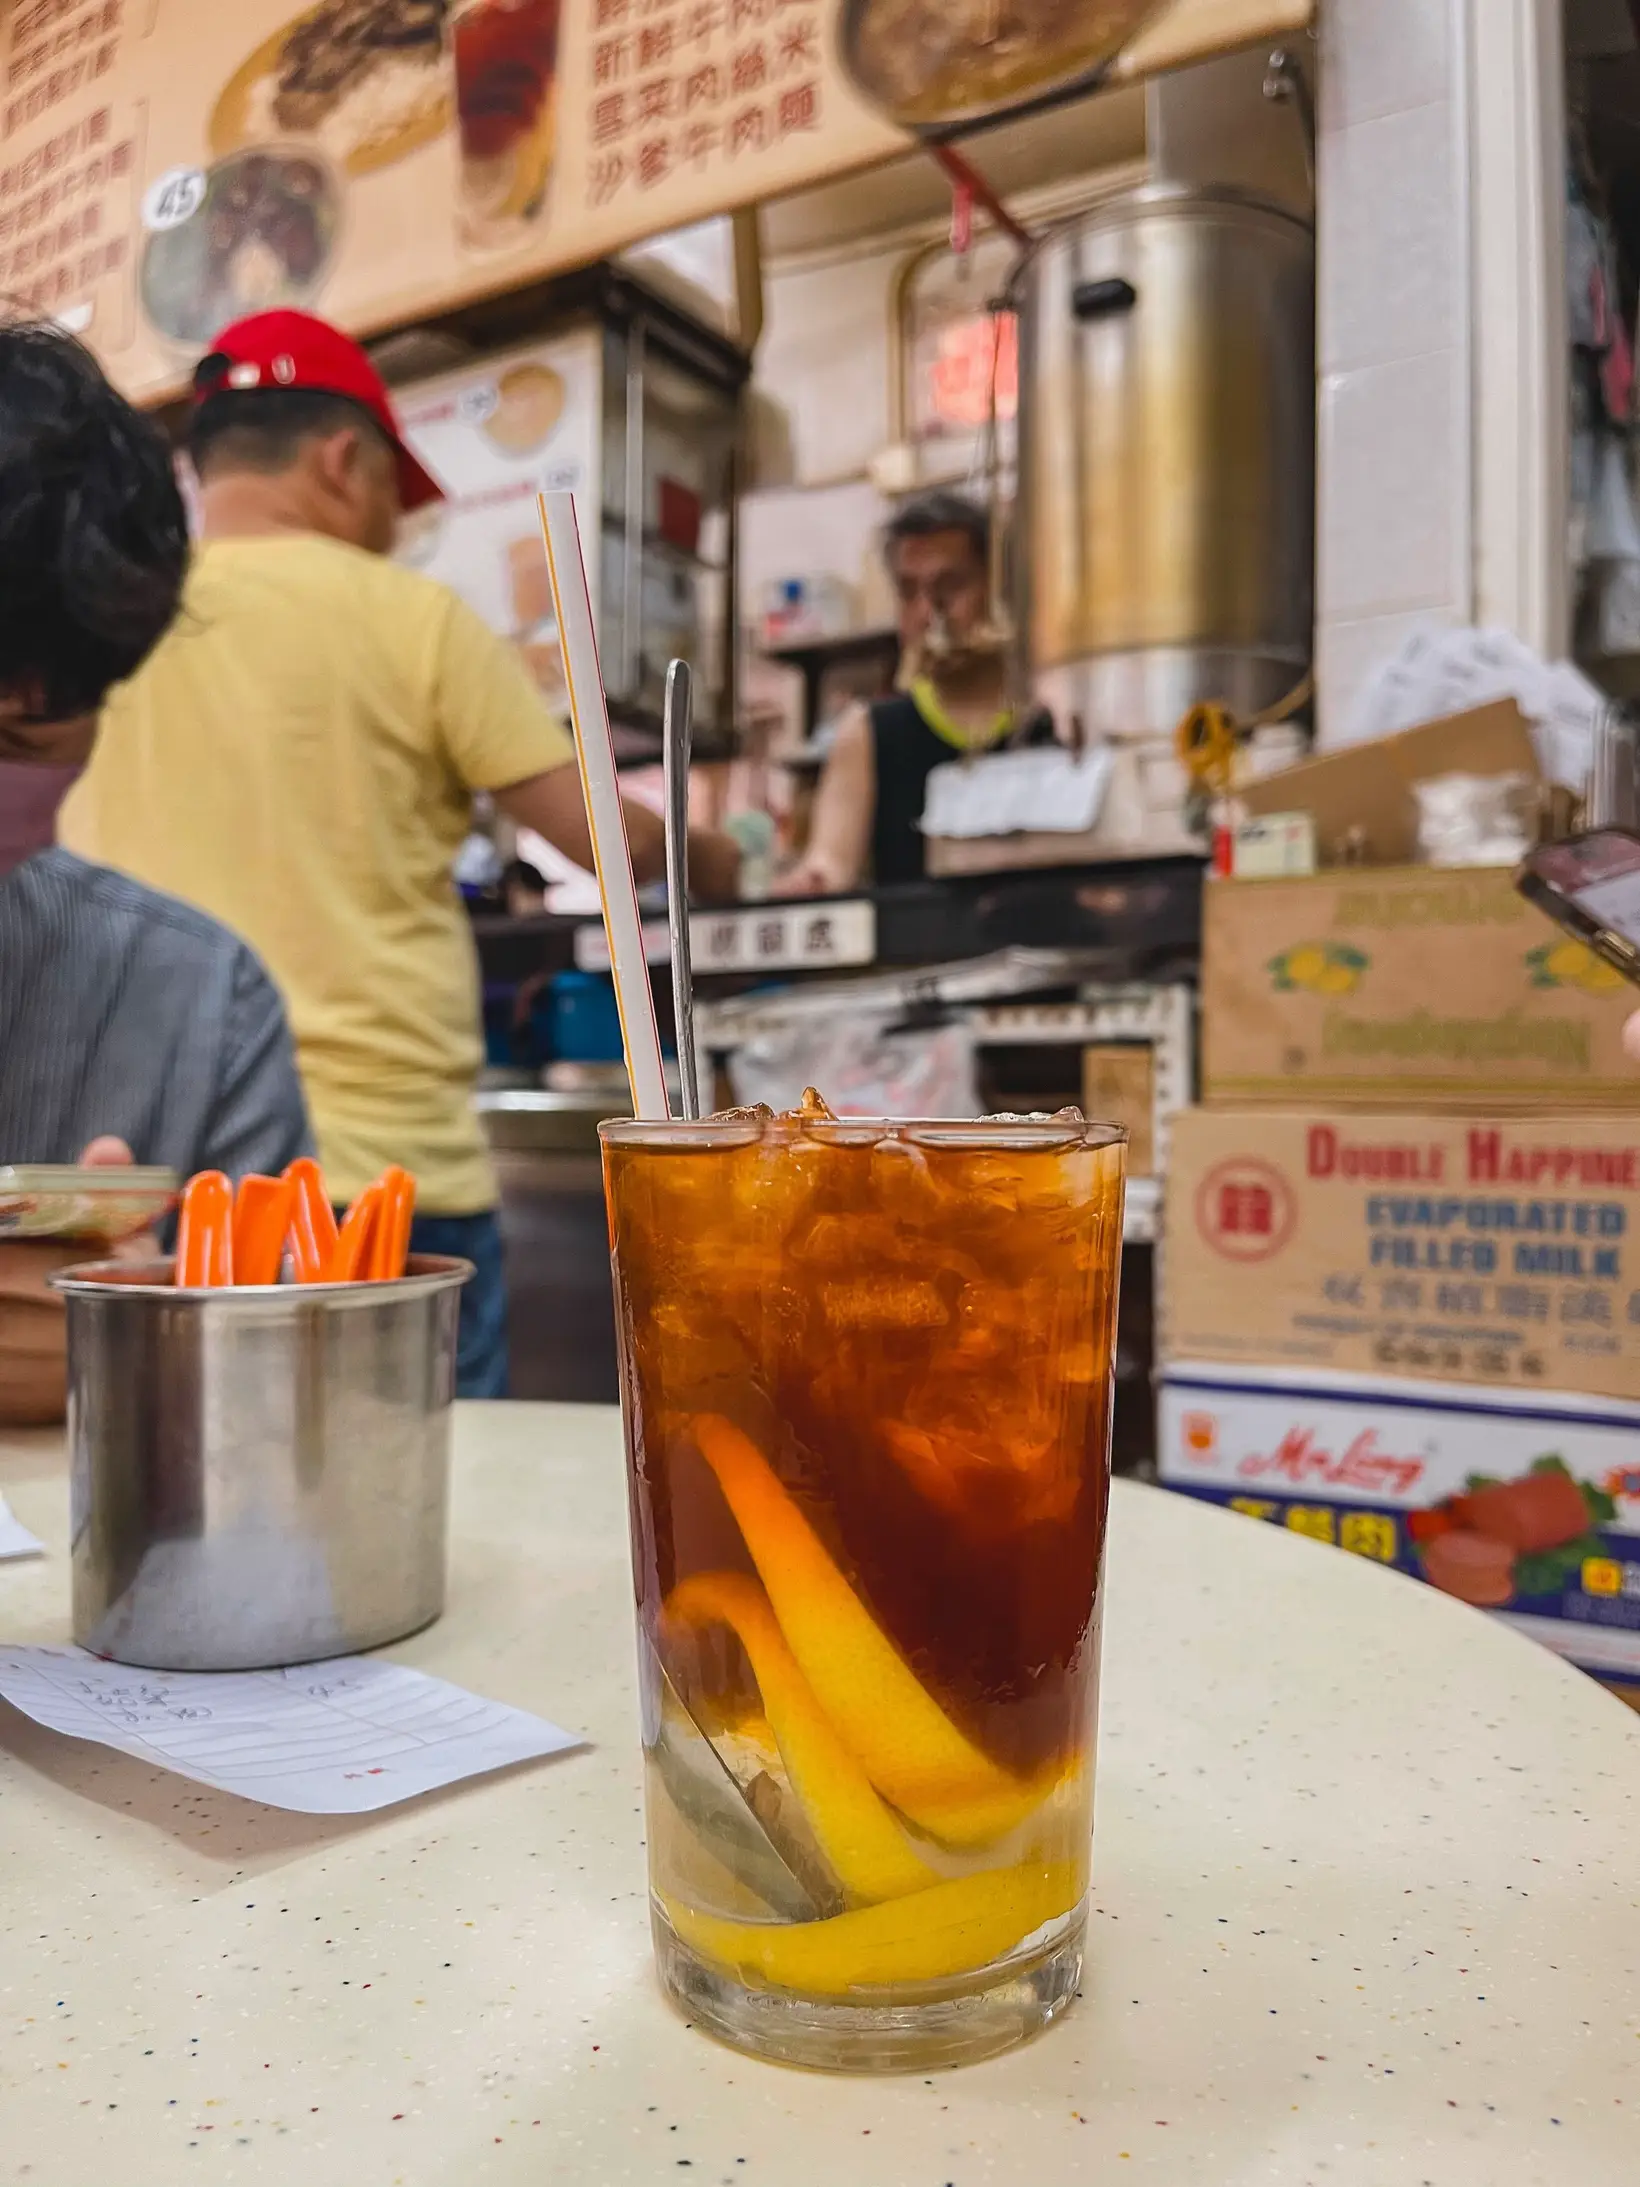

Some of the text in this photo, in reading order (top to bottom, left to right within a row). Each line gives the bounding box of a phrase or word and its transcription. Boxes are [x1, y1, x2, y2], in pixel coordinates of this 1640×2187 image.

[156, 174, 200, 218] 45
[1366, 1197, 1626, 1237] EVAPORATED
[1370, 1238, 1621, 1280] FILLED MILK
